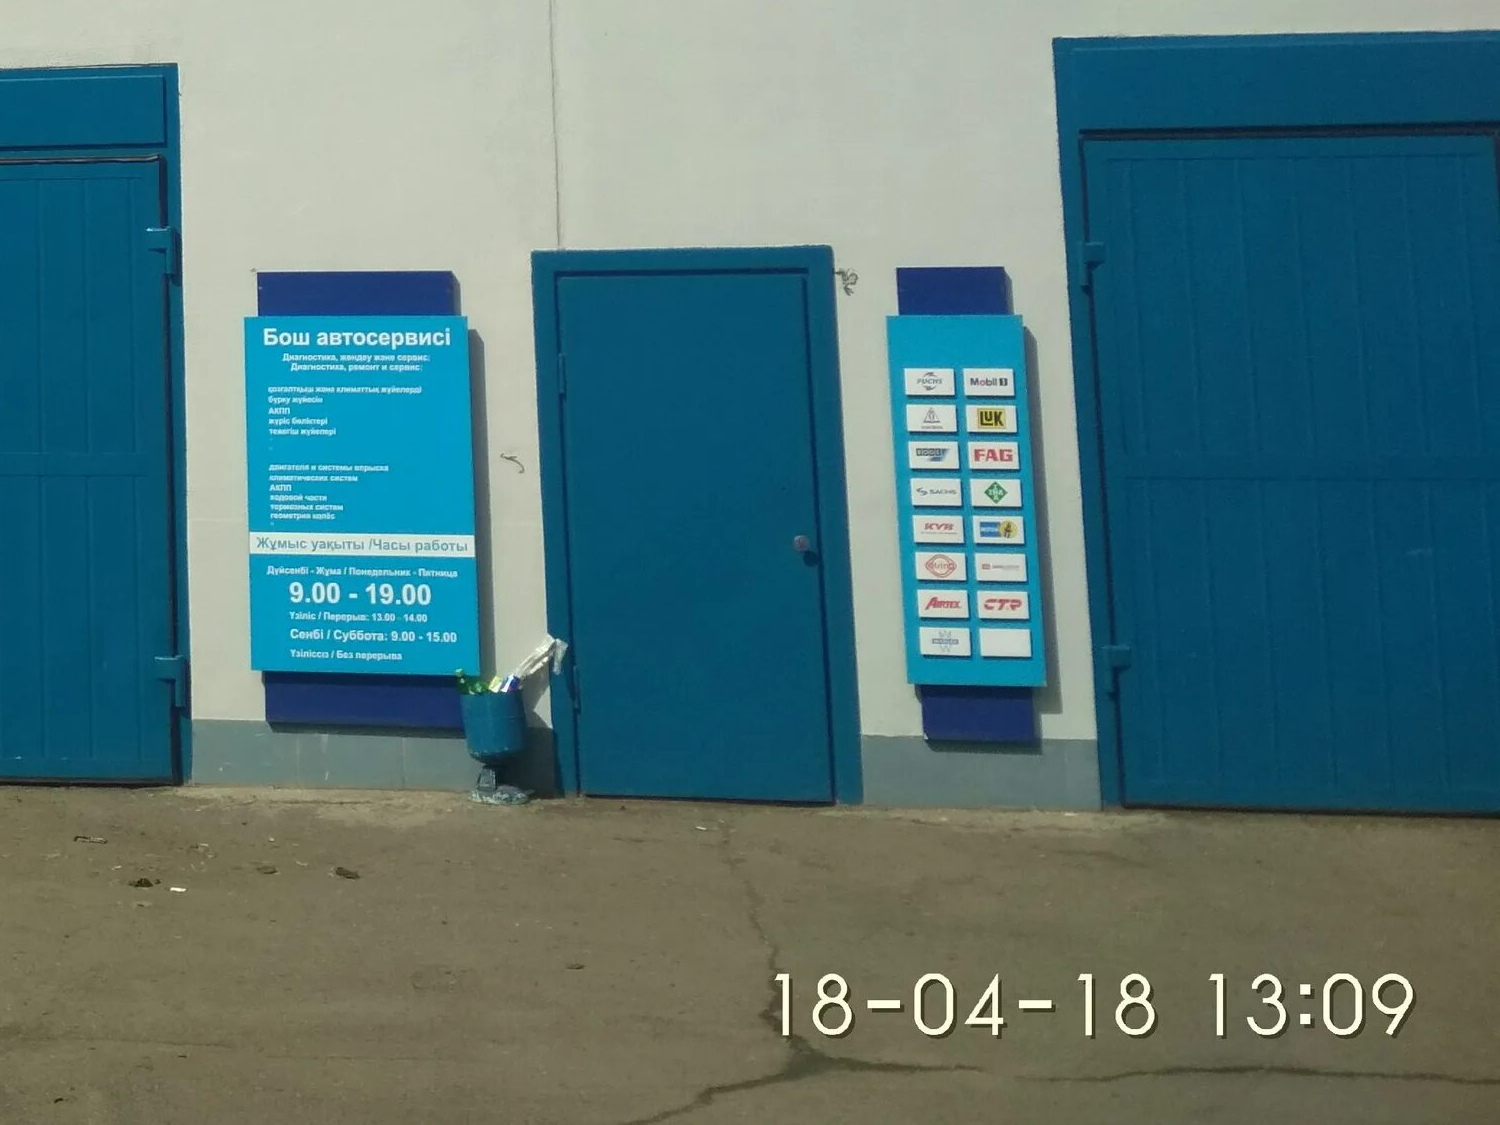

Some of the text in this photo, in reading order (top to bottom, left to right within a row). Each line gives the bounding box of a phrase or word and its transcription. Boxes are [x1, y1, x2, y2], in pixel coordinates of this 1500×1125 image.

[263, 327, 450, 350] Бош автосервисі
[970, 378, 997, 386] Mobil
[974, 449, 1013, 462] FAG
[415, 539, 468, 553] работы
[349, 568, 411, 577] Понедельник
[418, 569, 458, 577] Пятница
[289, 581, 341, 604] 9.00
[365, 583, 432, 605] 19.00
[372, 614, 396, 622] 13.00
[333, 630, 388, 643] Суббота:
[391, 631, 415, 641] 9.00
[426, 632, 457, 643] 15.00
